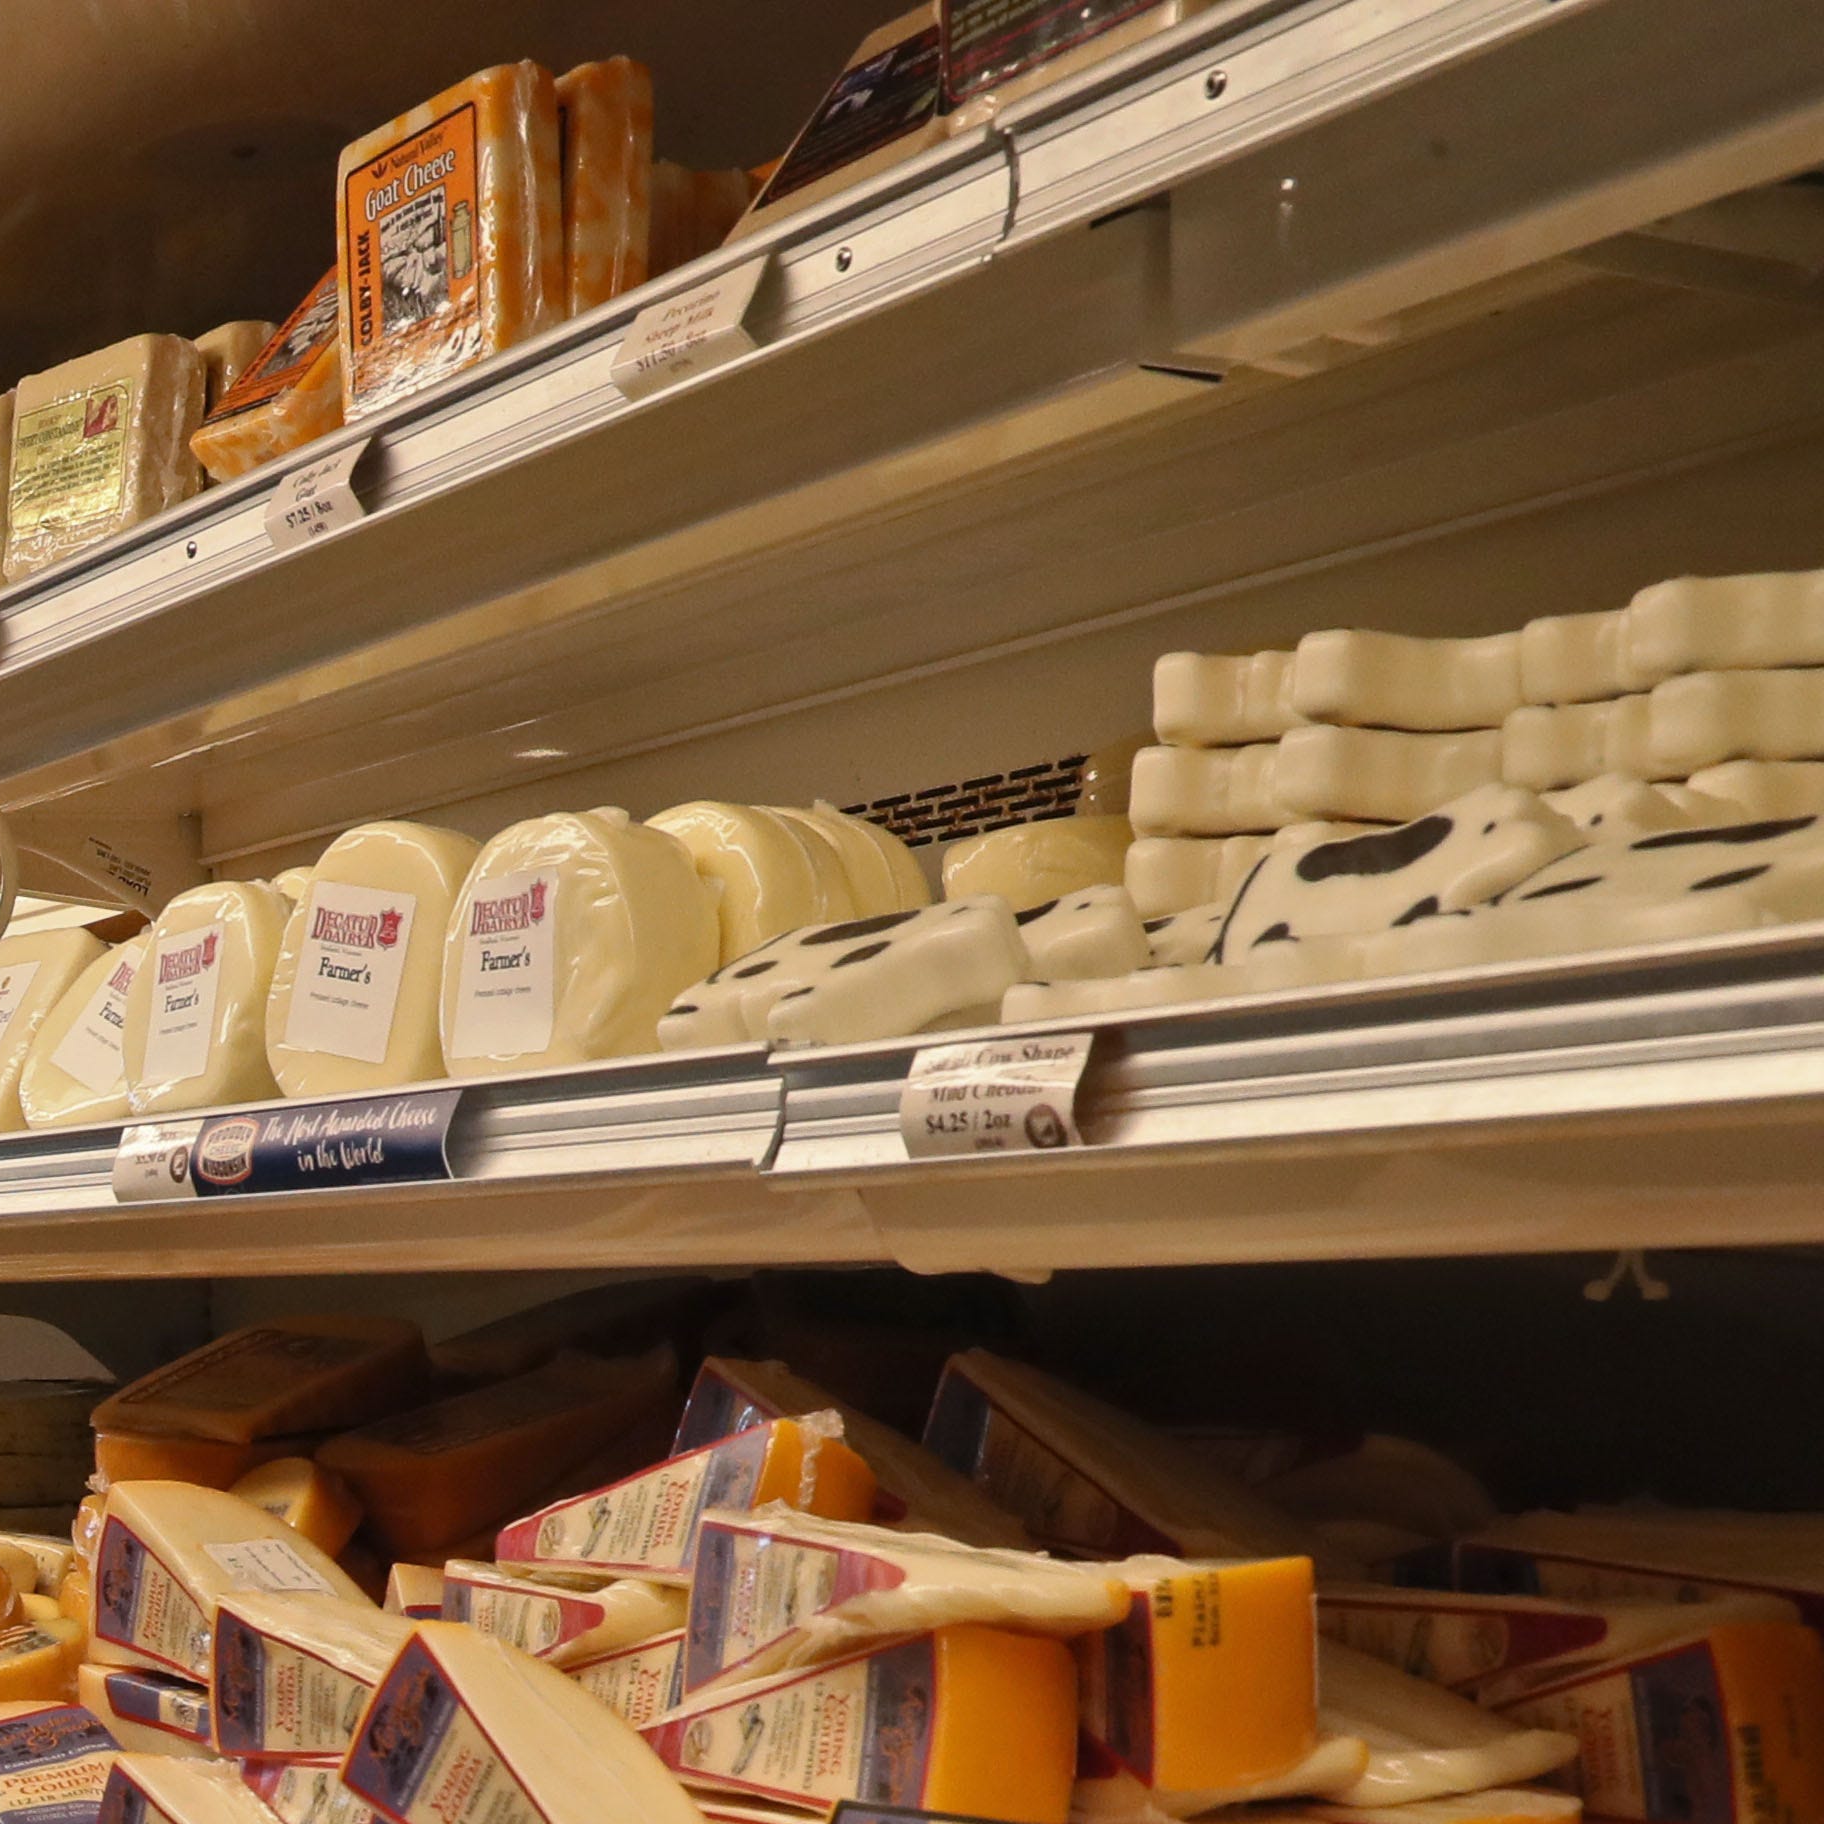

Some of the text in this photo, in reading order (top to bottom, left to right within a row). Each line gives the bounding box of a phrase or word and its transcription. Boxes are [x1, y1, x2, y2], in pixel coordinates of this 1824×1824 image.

[365, 178, 400, 222] Goat
[404, 148, 456, 197] Cheese
[360, 229, 374, 347] COLBY-JACK
[318, 956, 372, 986] Farmer's
[480, 949, 532, 973] Farmer's
[165, 991, 200, 1014] Farmer's
[261, 1100, 438, 1145] The Most Awarded Cheese
[297, 1137, 386, 1172] in the World
[652, 1480, 681, 1549] GOUDA
[663, 1479, 690, 1546] YOUNG
[815, 1693, 840, 1777] GOUDA
[828, 1694, 851, 1776] YOUNG
[3, 1761, 106, 1789] PREMIUM
[19, 1773, 104, 1796] GOUDA
[430, 1745, 471, 1811] YOUNG
